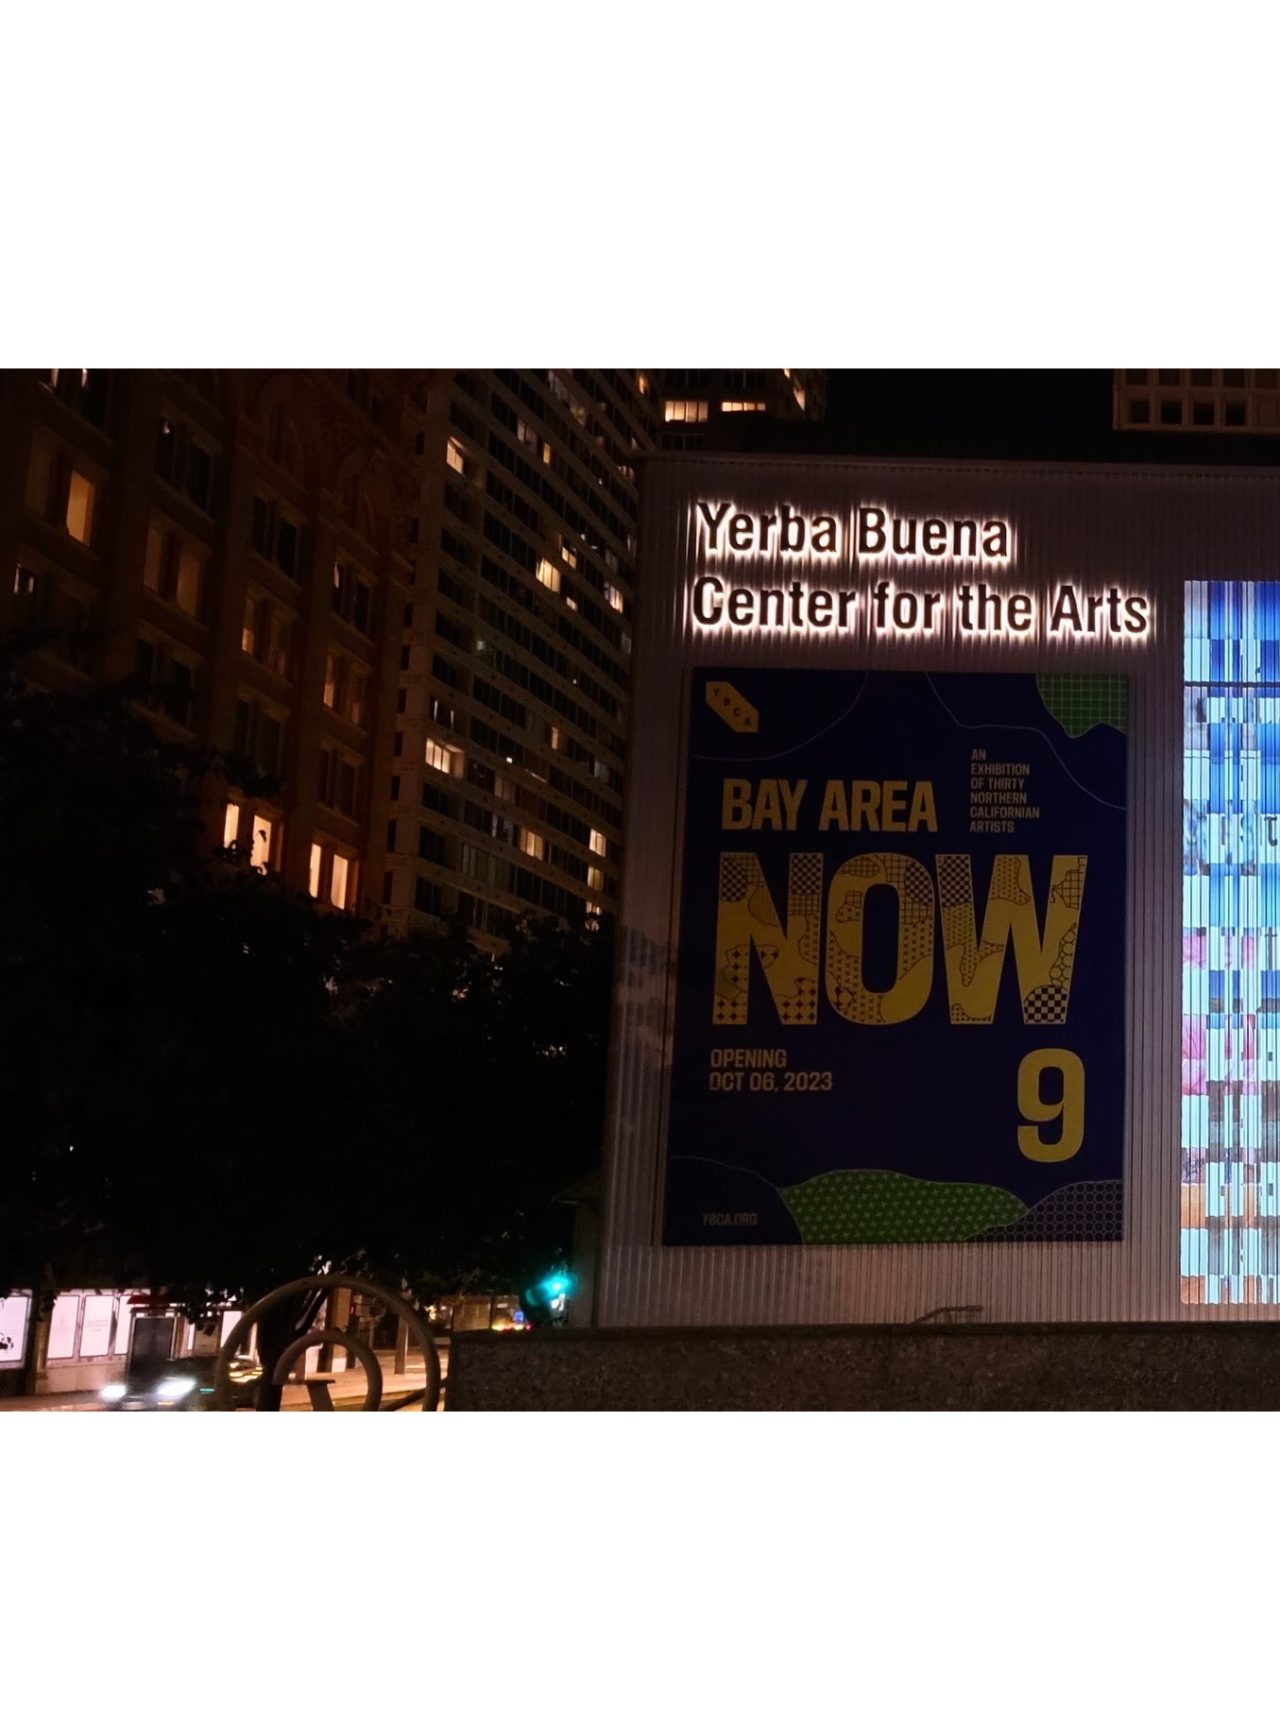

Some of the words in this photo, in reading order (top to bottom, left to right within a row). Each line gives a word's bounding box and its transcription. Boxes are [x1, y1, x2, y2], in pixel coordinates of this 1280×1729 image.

[697, 502, 838, 553] Yerba
[857, 506, 1009, 557] Buena
[692, 576, 857, 627] Center
[872, 581, 941, 629] for
[959, 583, 1033, 631] the
[1049, 584, 1149, 633] Arts
[970, 748, 987, 761] AN
[970, 763, 1031, 776] EXHIBITION
[970, 777, 985, 790] OF
[987, 778, 1025, 790] THIRTY
[721, 778, 808, 831] BAY
[818, 779, 938, 833] AREA
[970, 792, 1027, 804] NORTHERN
[970, 806, 1040, 819] CALIFORNIAN
[970, 820, 1015, 833] ARTISTS
[712, 851, 1088, 1026] NOW
[709, 1048, 787, 1069] OPENING
[708, 1071, 743, 1092] OCT
[783, 1071, 833, 1092] 2023
[1016, 1047, 1086, 1164] 9
[702, 1212, 758, 1227] YBCA.ORG
